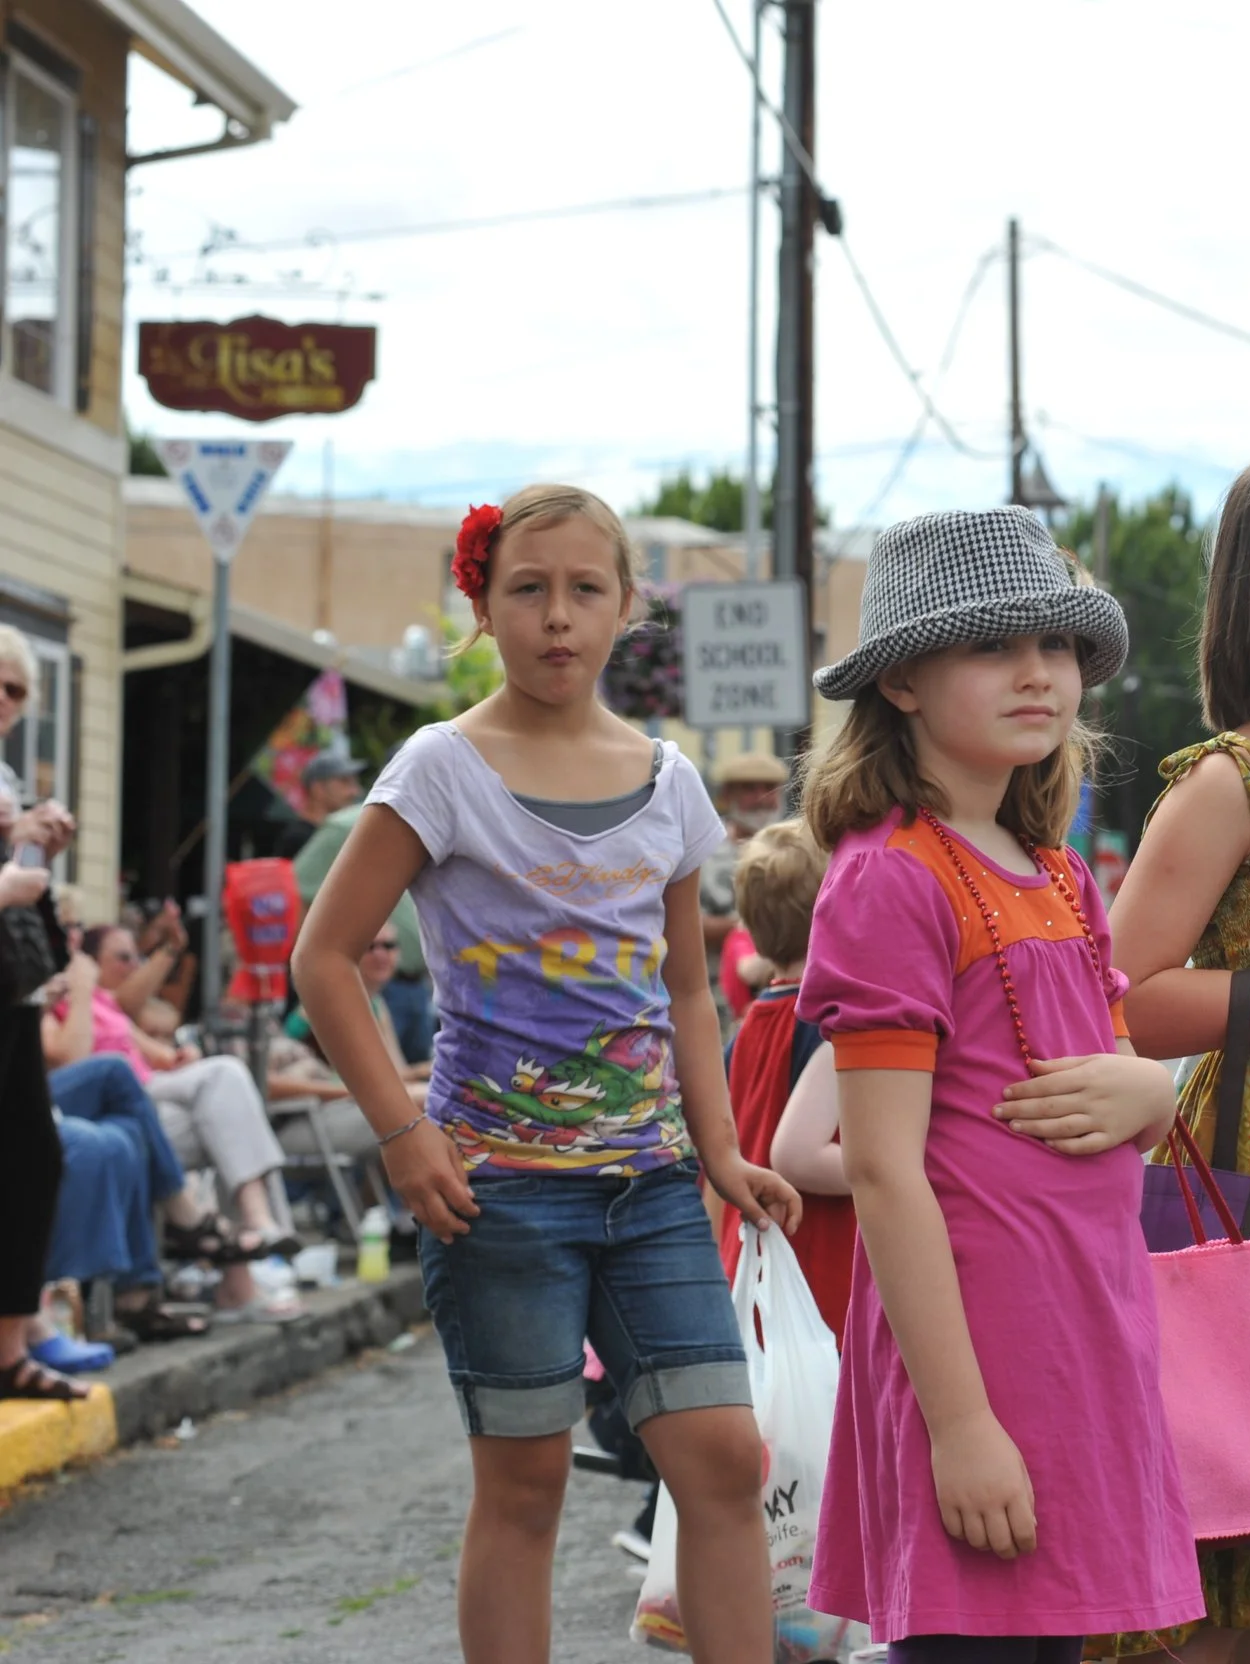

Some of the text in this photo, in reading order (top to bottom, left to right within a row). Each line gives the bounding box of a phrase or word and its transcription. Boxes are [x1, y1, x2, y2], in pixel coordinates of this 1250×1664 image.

[716, 602, 768, 628] END
[700, 643, 786, 669] SCHOOL
[712, 682, 775, 710] ZONE
